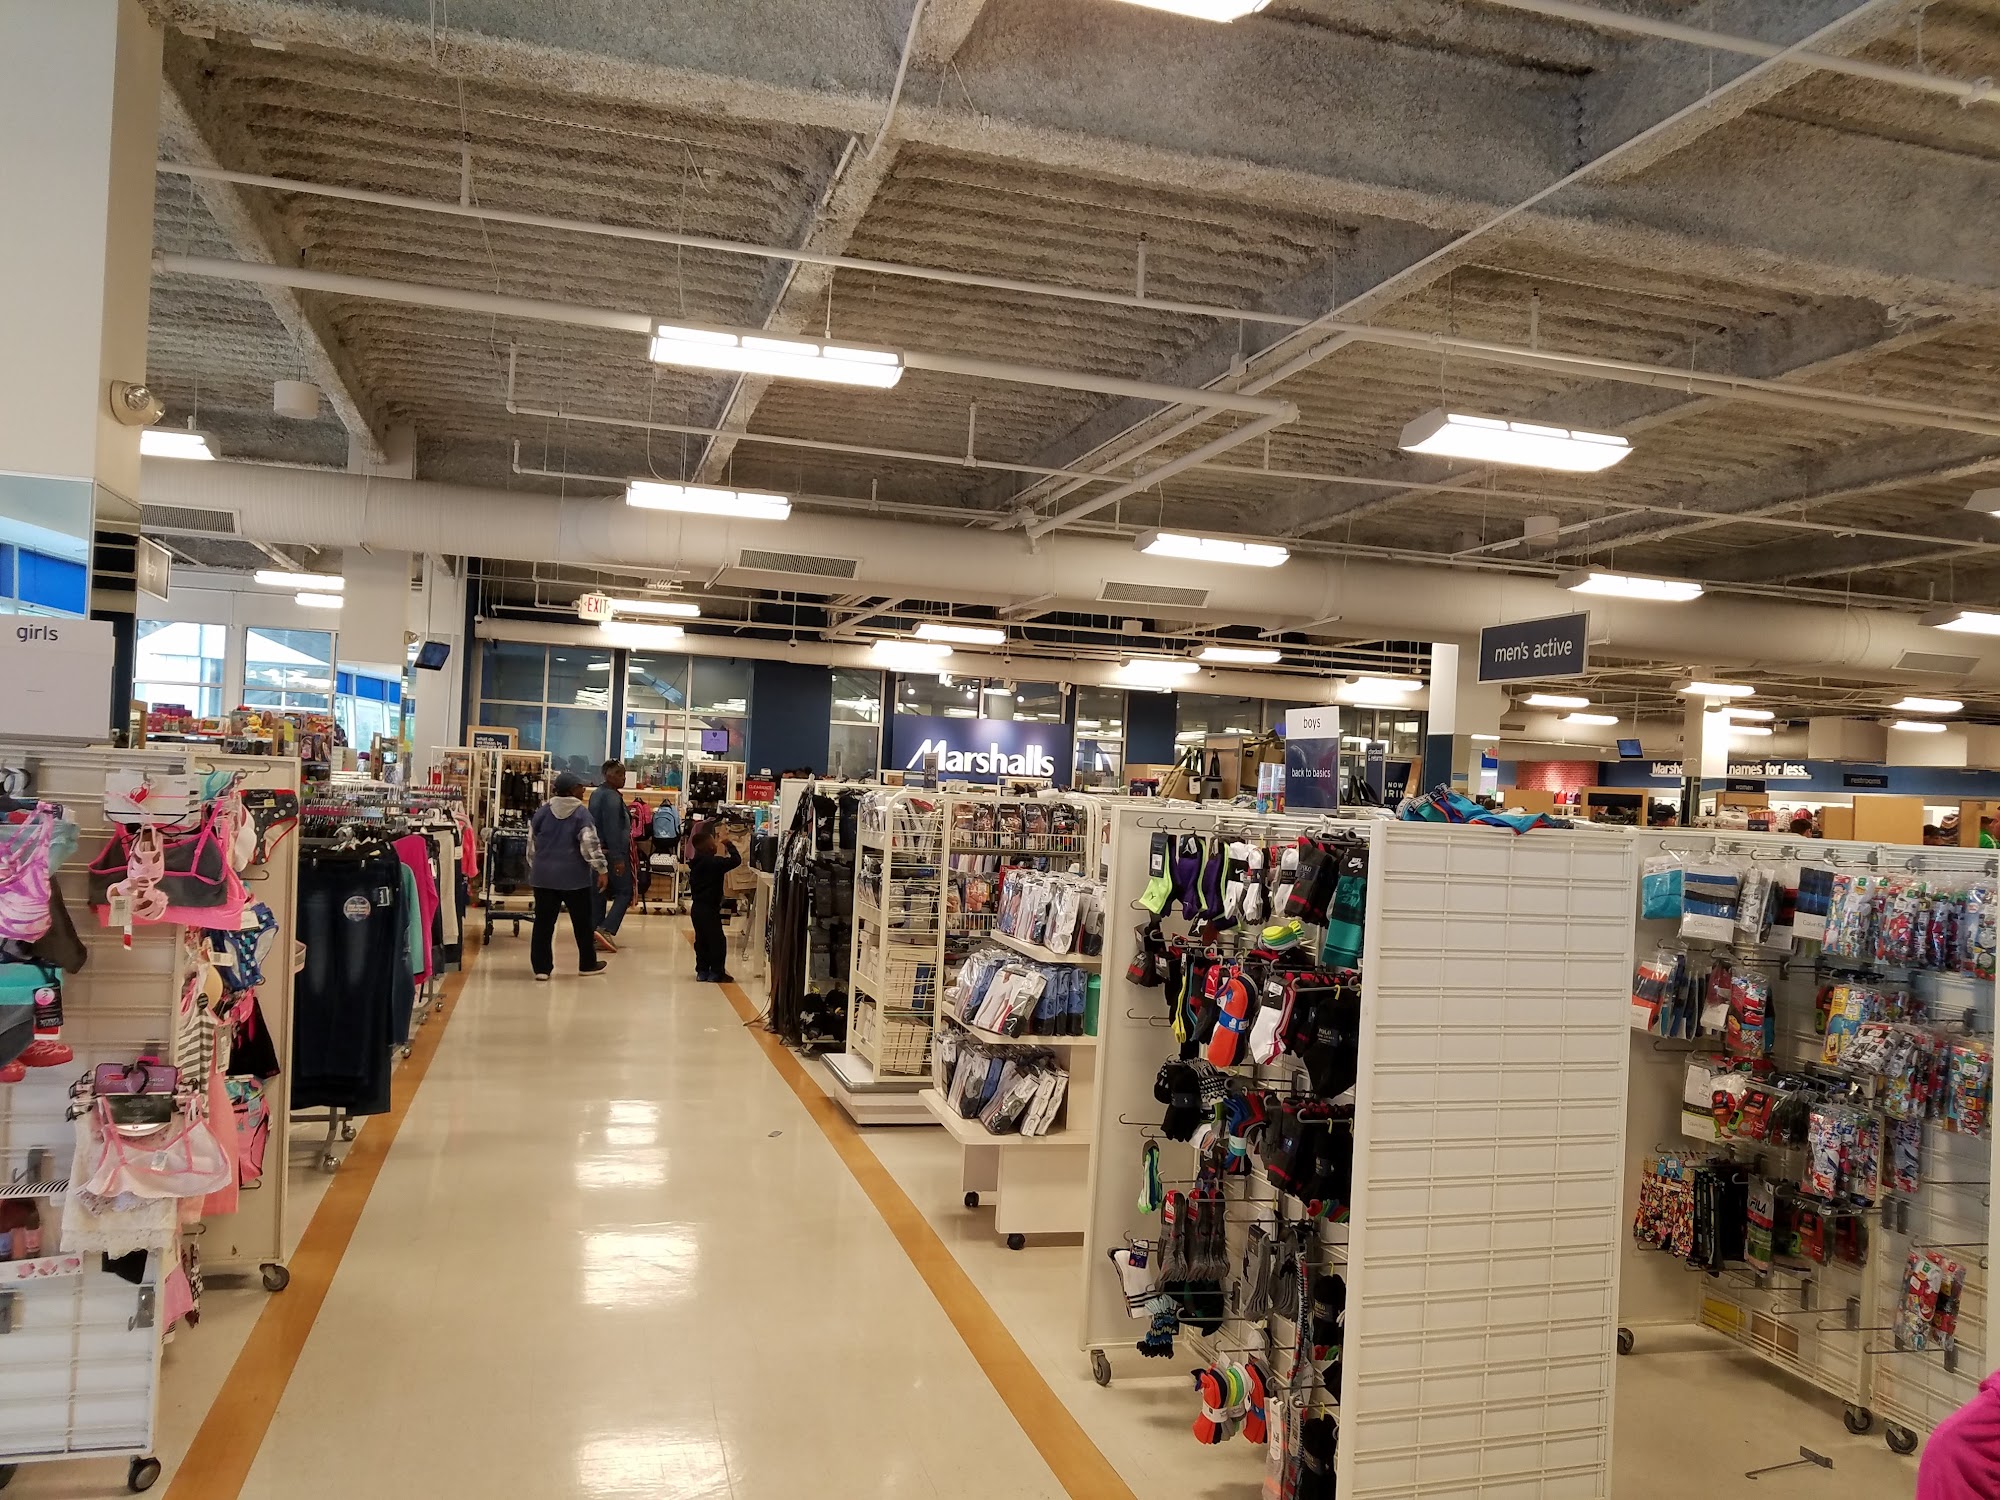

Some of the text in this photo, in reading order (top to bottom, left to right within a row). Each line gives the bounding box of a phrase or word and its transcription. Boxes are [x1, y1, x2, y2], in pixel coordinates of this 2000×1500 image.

[587, 597, 609, 614] EXIT
[16, 624, 59, 642] girls
[1494, 637, 1573, 663] men's active
[1303, 716, 1321, 731] boys
[905, 738, 1055, 777] Marshalls
[1291, 767, 1331, 778] back to basics
[1729, 764, 1763, 776] names
[1765, 761, 1782, 776] for
[1749, 1198, 1767, 1215] FILA
